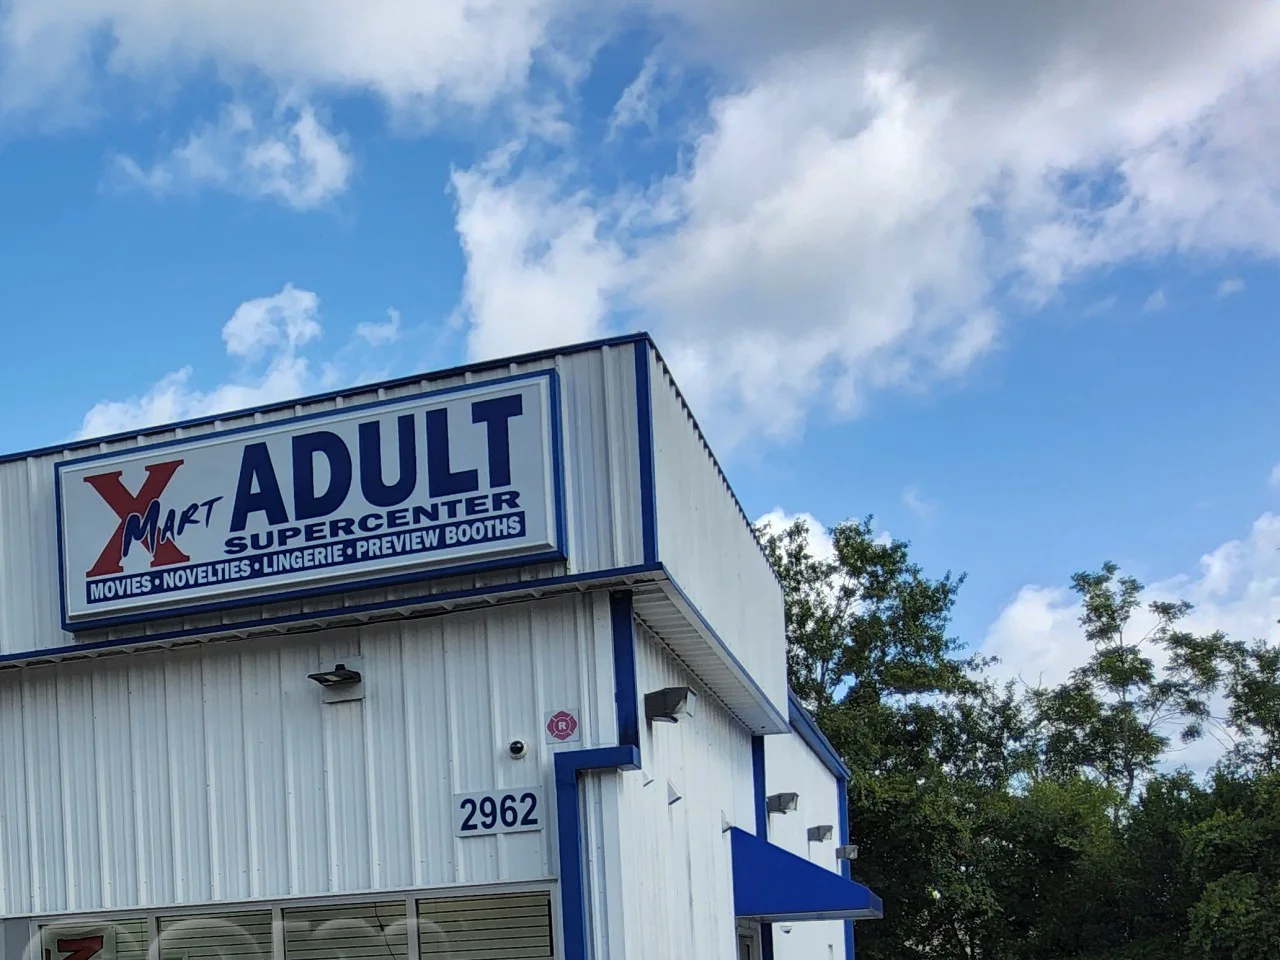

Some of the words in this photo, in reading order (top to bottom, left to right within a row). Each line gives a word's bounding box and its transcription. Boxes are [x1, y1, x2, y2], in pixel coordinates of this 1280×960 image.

[230, 393, 523, 532] ADULT
[83, 459, 190, 578] X
[122, 498, 224, 558] MART
[223, 491, 521, 555] SUPERCENTER
[90, 577, 153, 601] MOVIES
[163, 560, 252, 590] NOVELTIES
[263, 543, 345, 574] LINGERIE
[356, 529, 440, 560] PREVIEW
[445, 516, 521, 545] BOOTHS
[558, 721, 567, 730] R
[460, 792, 538, 831] 2962
